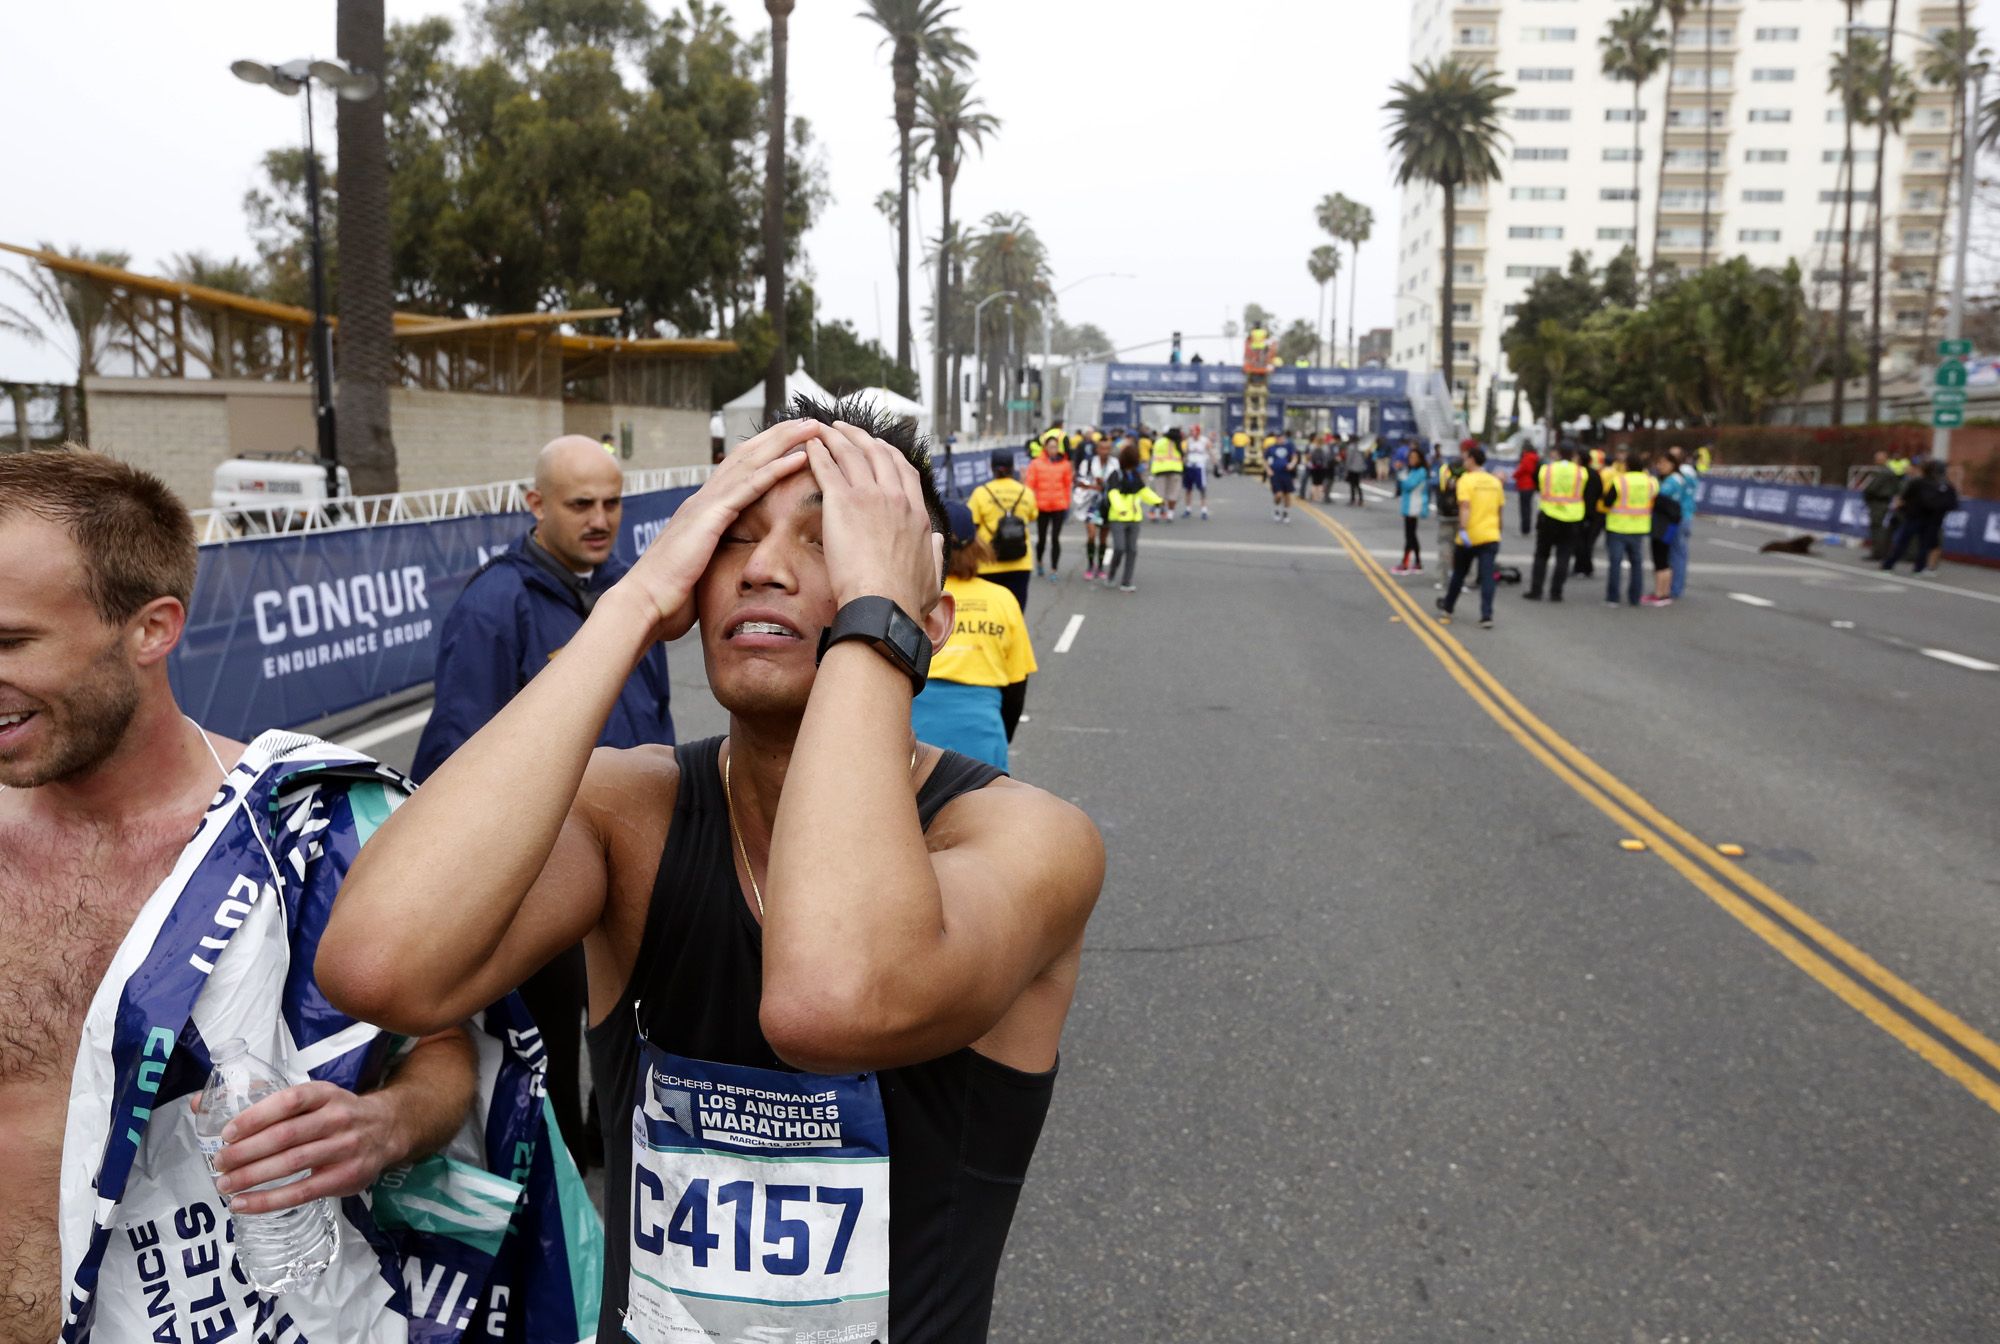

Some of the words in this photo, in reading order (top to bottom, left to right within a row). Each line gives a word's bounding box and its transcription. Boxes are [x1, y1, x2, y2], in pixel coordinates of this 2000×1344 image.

[253, 565, 430, 645] CONQUR
[953, 619, 1006, 638] ALKER
[263, 632, 378, 679] ENDURANCE
[382, 618, 433, 648] GROUP
[698, 1093, 737, 1110] LOS
[744, 1101, 840, 1121] ANGELES
[717, 1082, 838, 1104] PERFORMANCE
[700, 1110, 842, 1139] MARATHON
[729, 1134, 766, 1147] MARCH
[634, 1162, 864, 1277] C4157
[795, 1321, 878, 1341] SKECHERS
